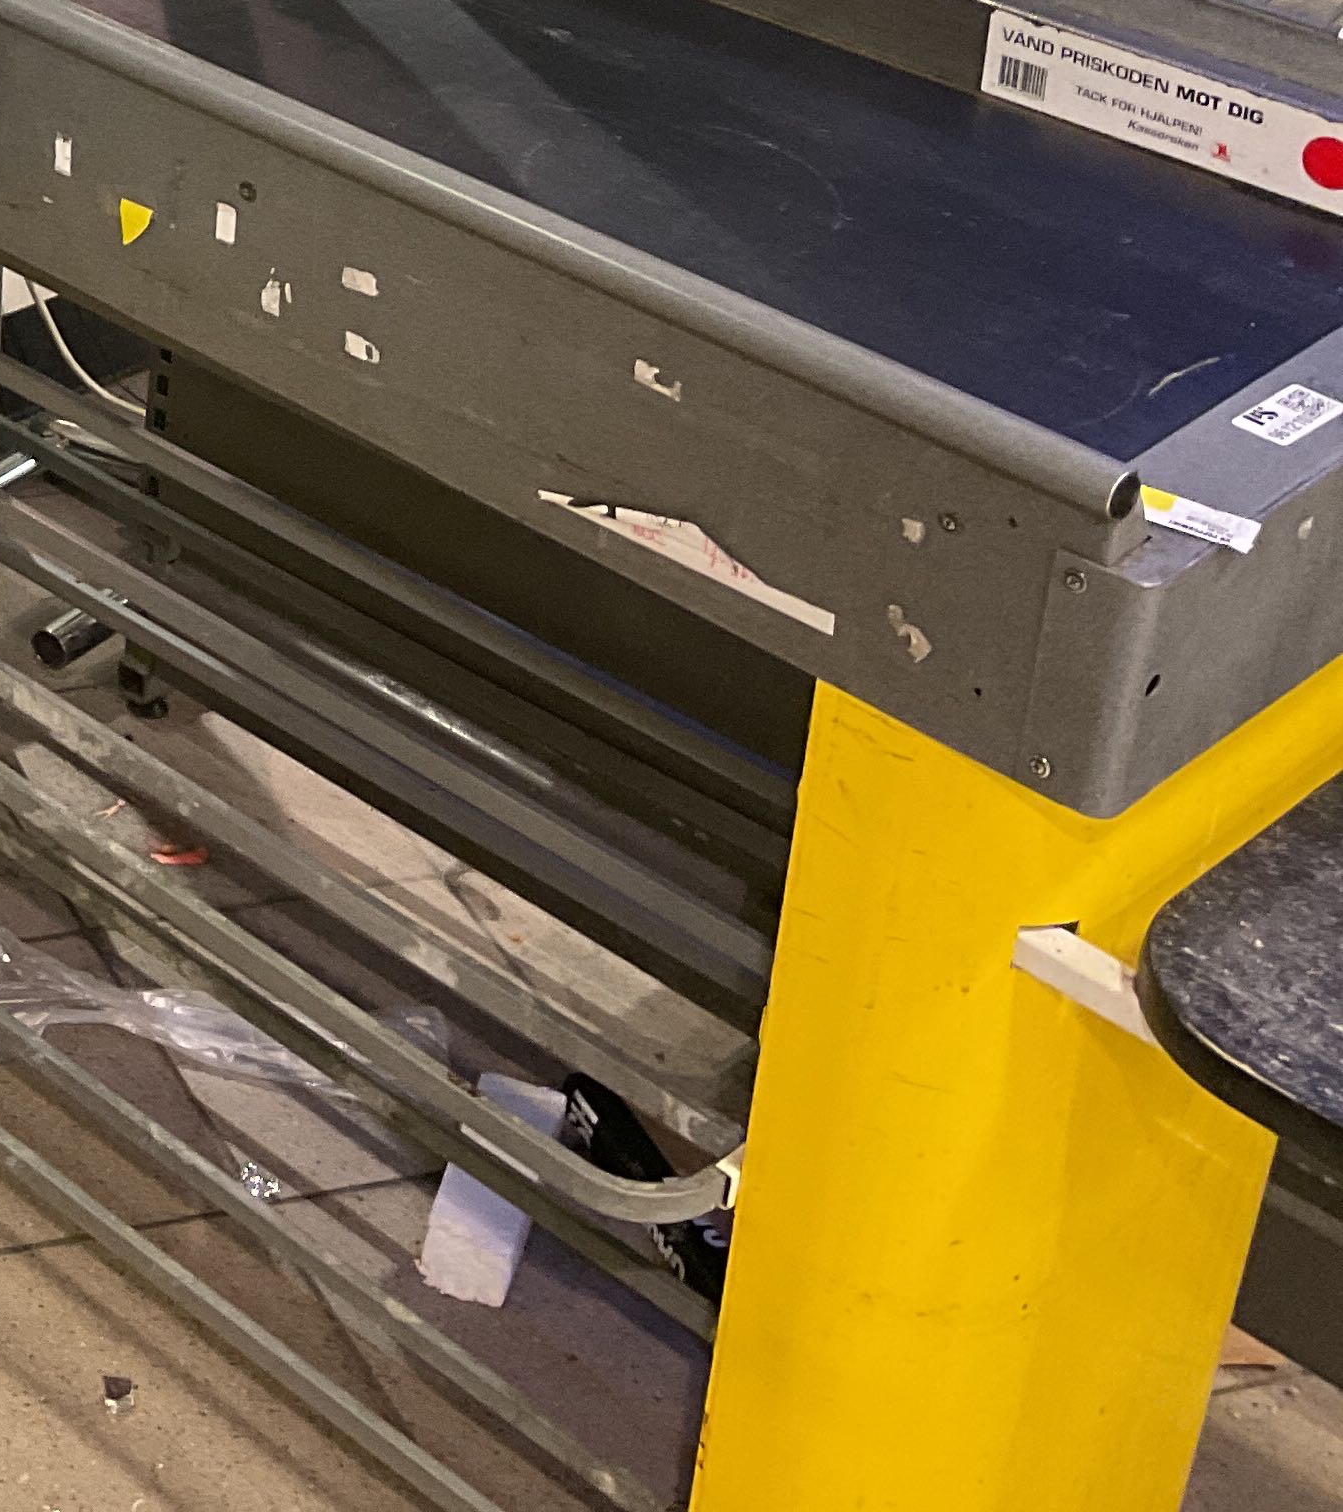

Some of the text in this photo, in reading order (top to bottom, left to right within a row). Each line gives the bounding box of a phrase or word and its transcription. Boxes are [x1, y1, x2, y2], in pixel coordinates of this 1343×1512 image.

[1060, 46, 1170, 94] PRISKODEN
[1176, 84, 1223, 111] MOT
[1227, 100, 1265, 125] DIG
[1075, 85, 1108, 104] TACK
